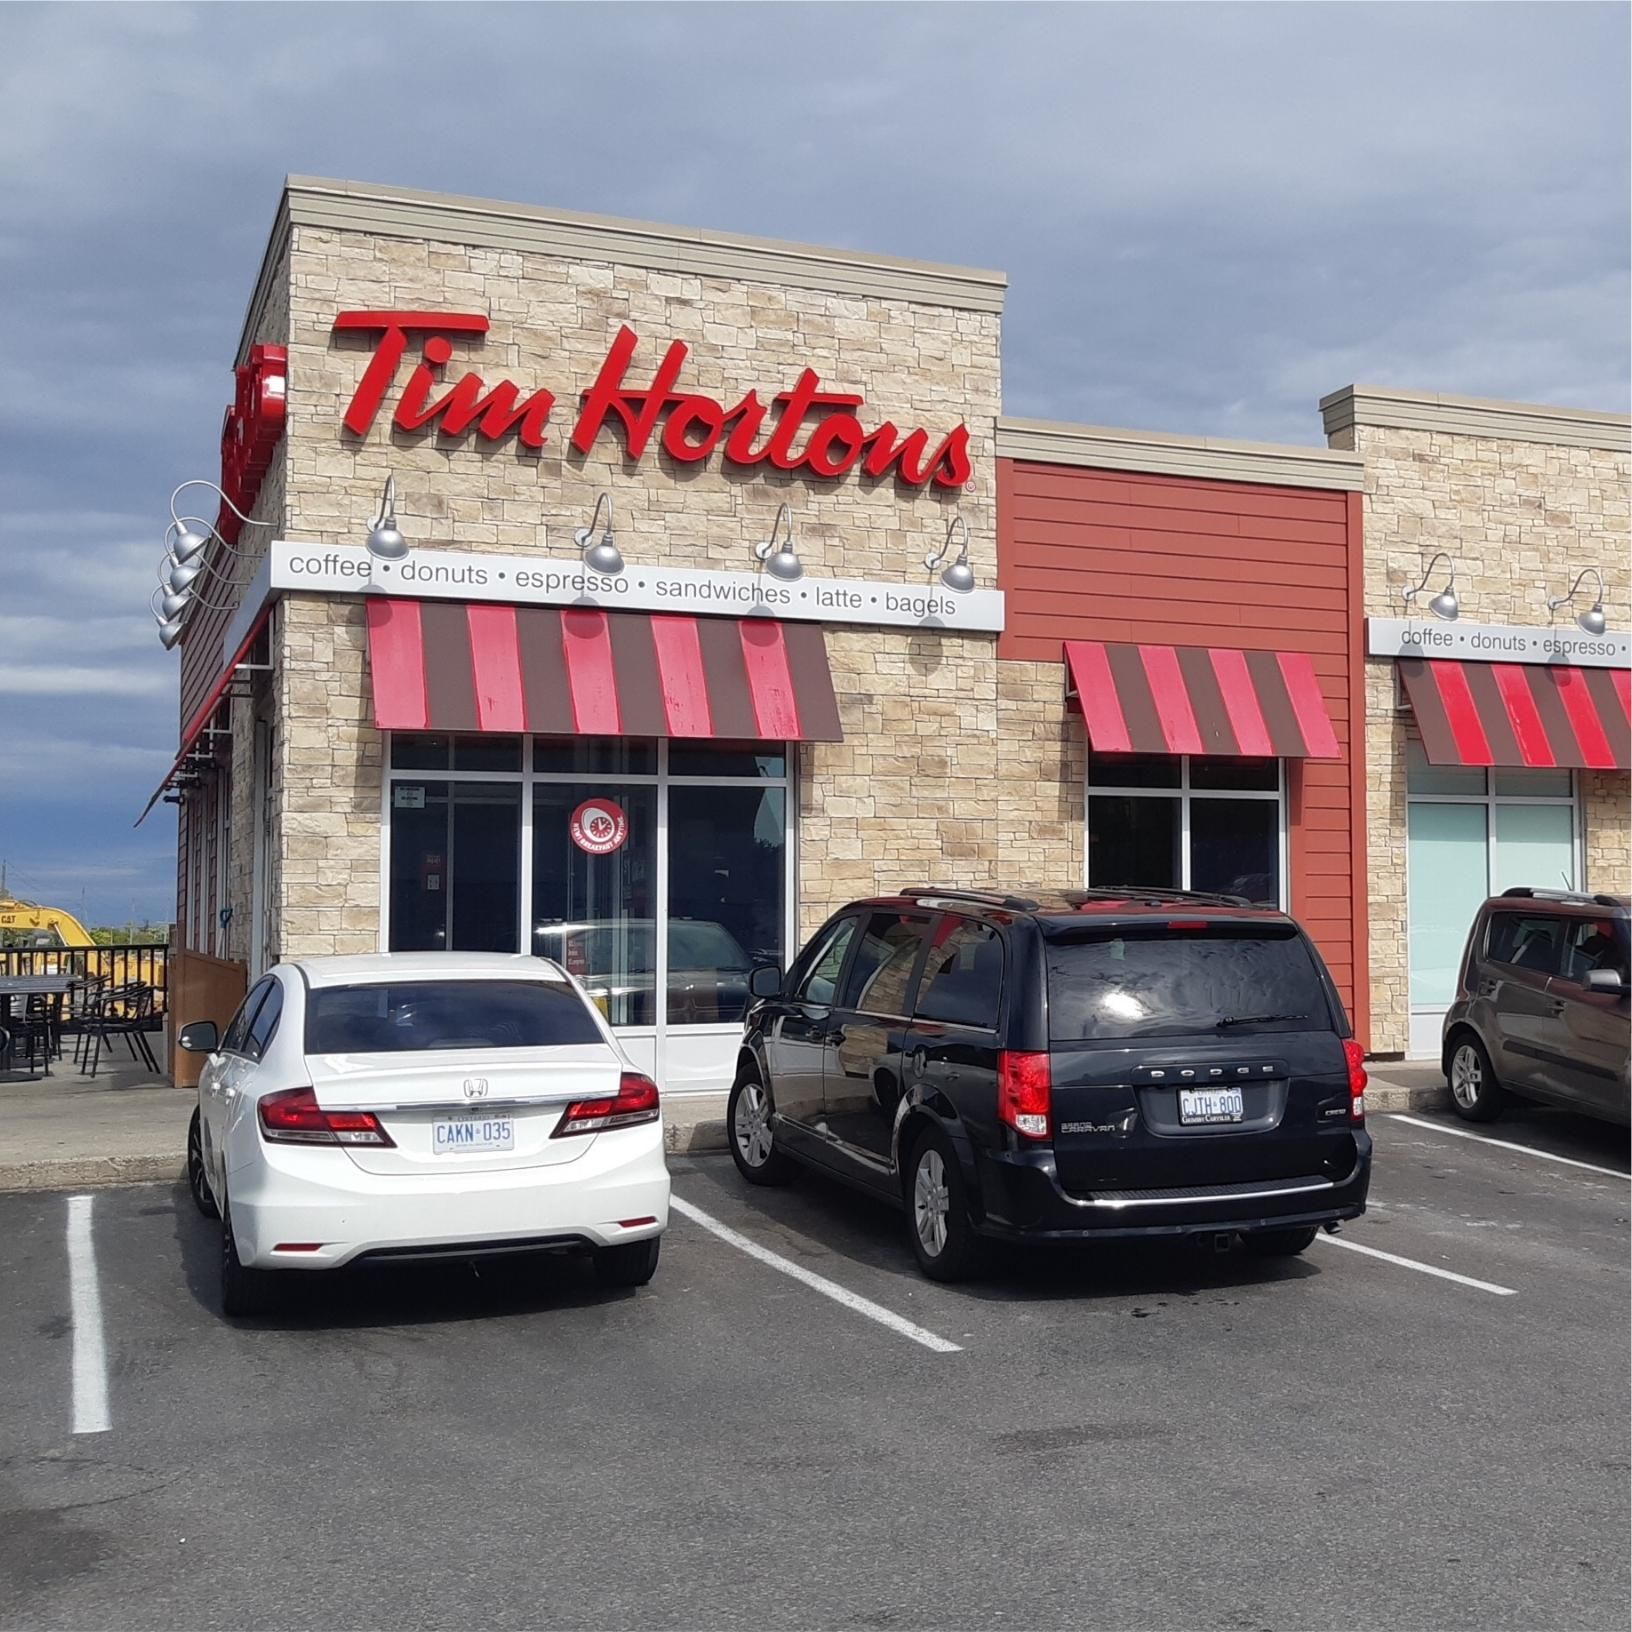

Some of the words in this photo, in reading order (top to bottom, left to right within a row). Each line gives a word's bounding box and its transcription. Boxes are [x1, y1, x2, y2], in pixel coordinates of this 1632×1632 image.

[334, 310, 556, 449] Tim
[570, 324, 972, 489] Hortons
[289, 554, 372, 578] coffee
[400, 559, 489, 585] donuts
[515, 570, 630, 594] espresso
[655, 579, 791, 604] sandwiches
[815, 586, 863, 608] latte
[885, 591, 957, 618] bagels
[1401, 627, 1453, 647] coffee
[1471, 632, 1527, 652] donuts
[1543, 638, 1617, 657] espresso
[1, 915, 16, 923] CAT
[1150, 1065, 1274, 1078] DODGE
